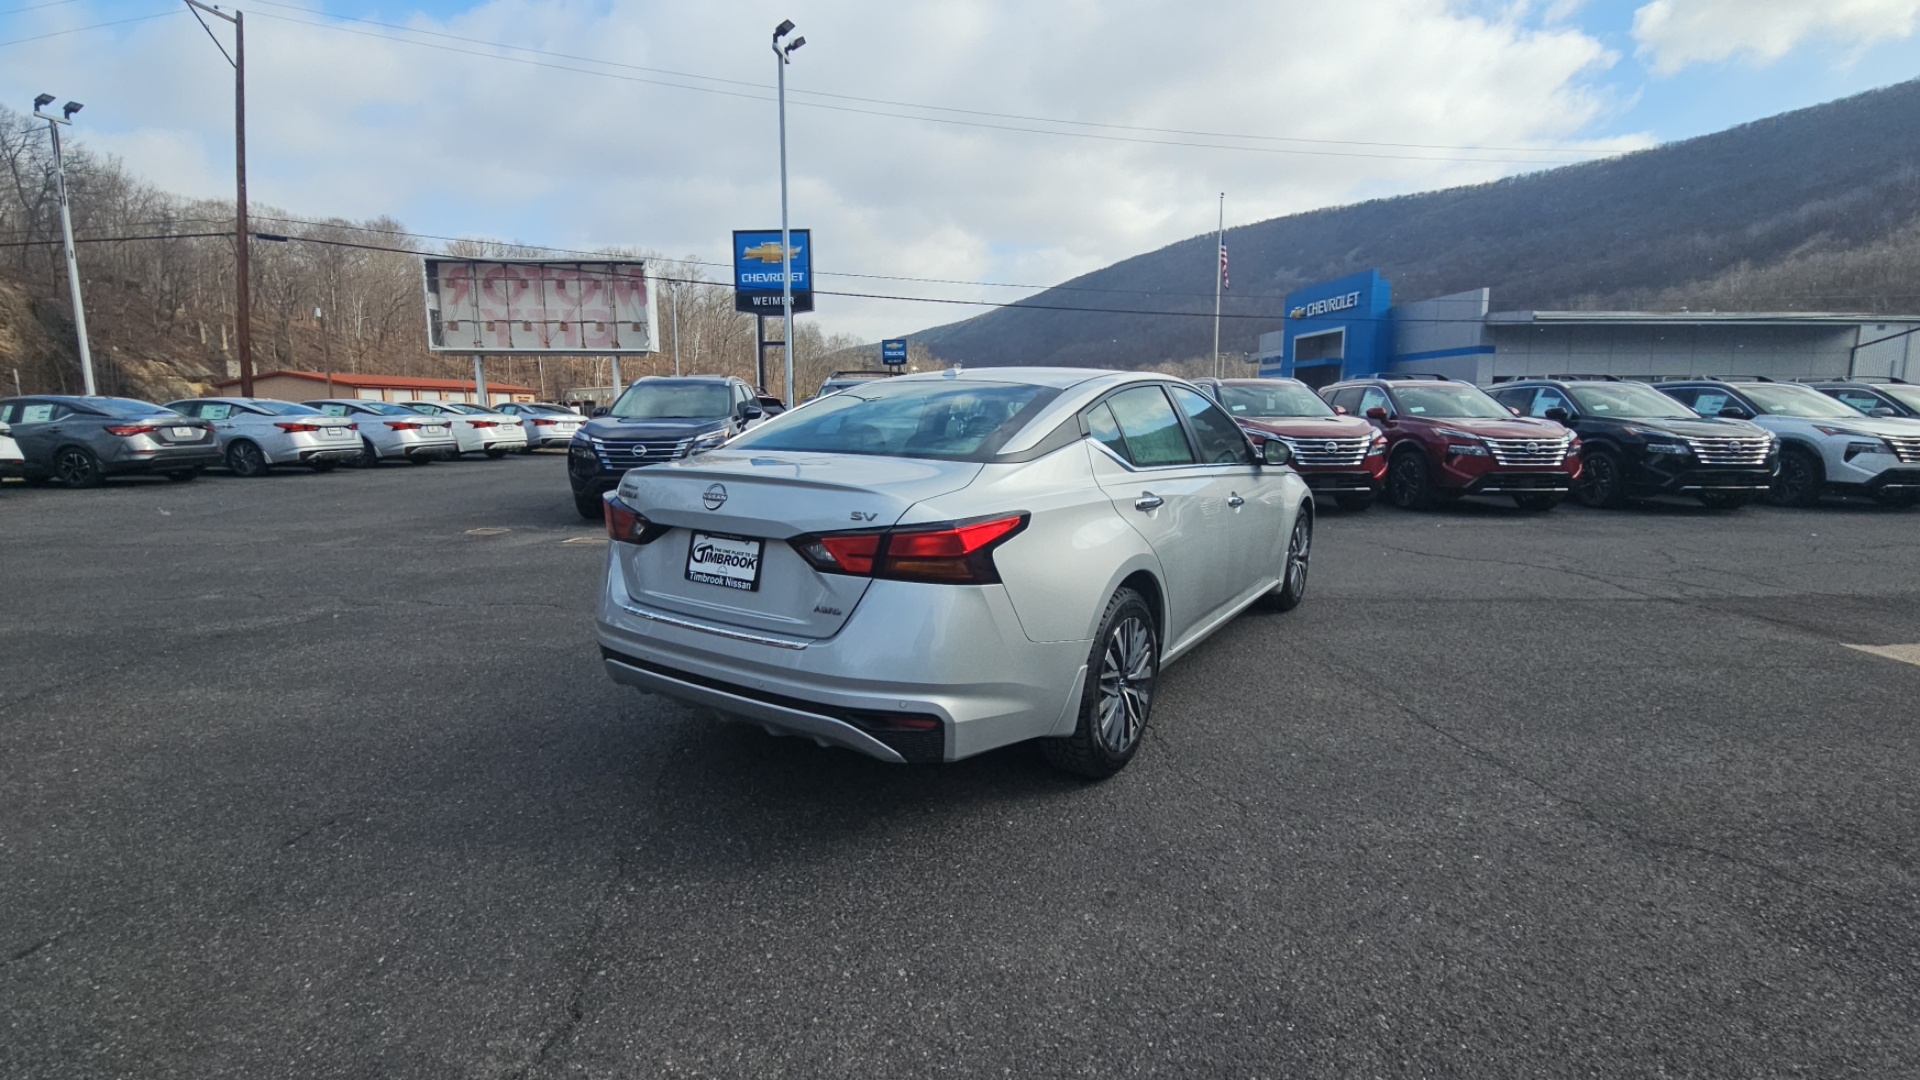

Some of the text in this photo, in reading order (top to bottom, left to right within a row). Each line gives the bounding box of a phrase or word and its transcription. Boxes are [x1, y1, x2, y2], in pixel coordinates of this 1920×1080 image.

[741, 272, 804, 283] CHEVROET
[1307, 291, 1360, 317] CHEVROLET
[850, 511, 878, 521] SV
[692, 543, 757, 570] TIMBROOK
[690, 572, 751, 590] Timbrook Nissan
